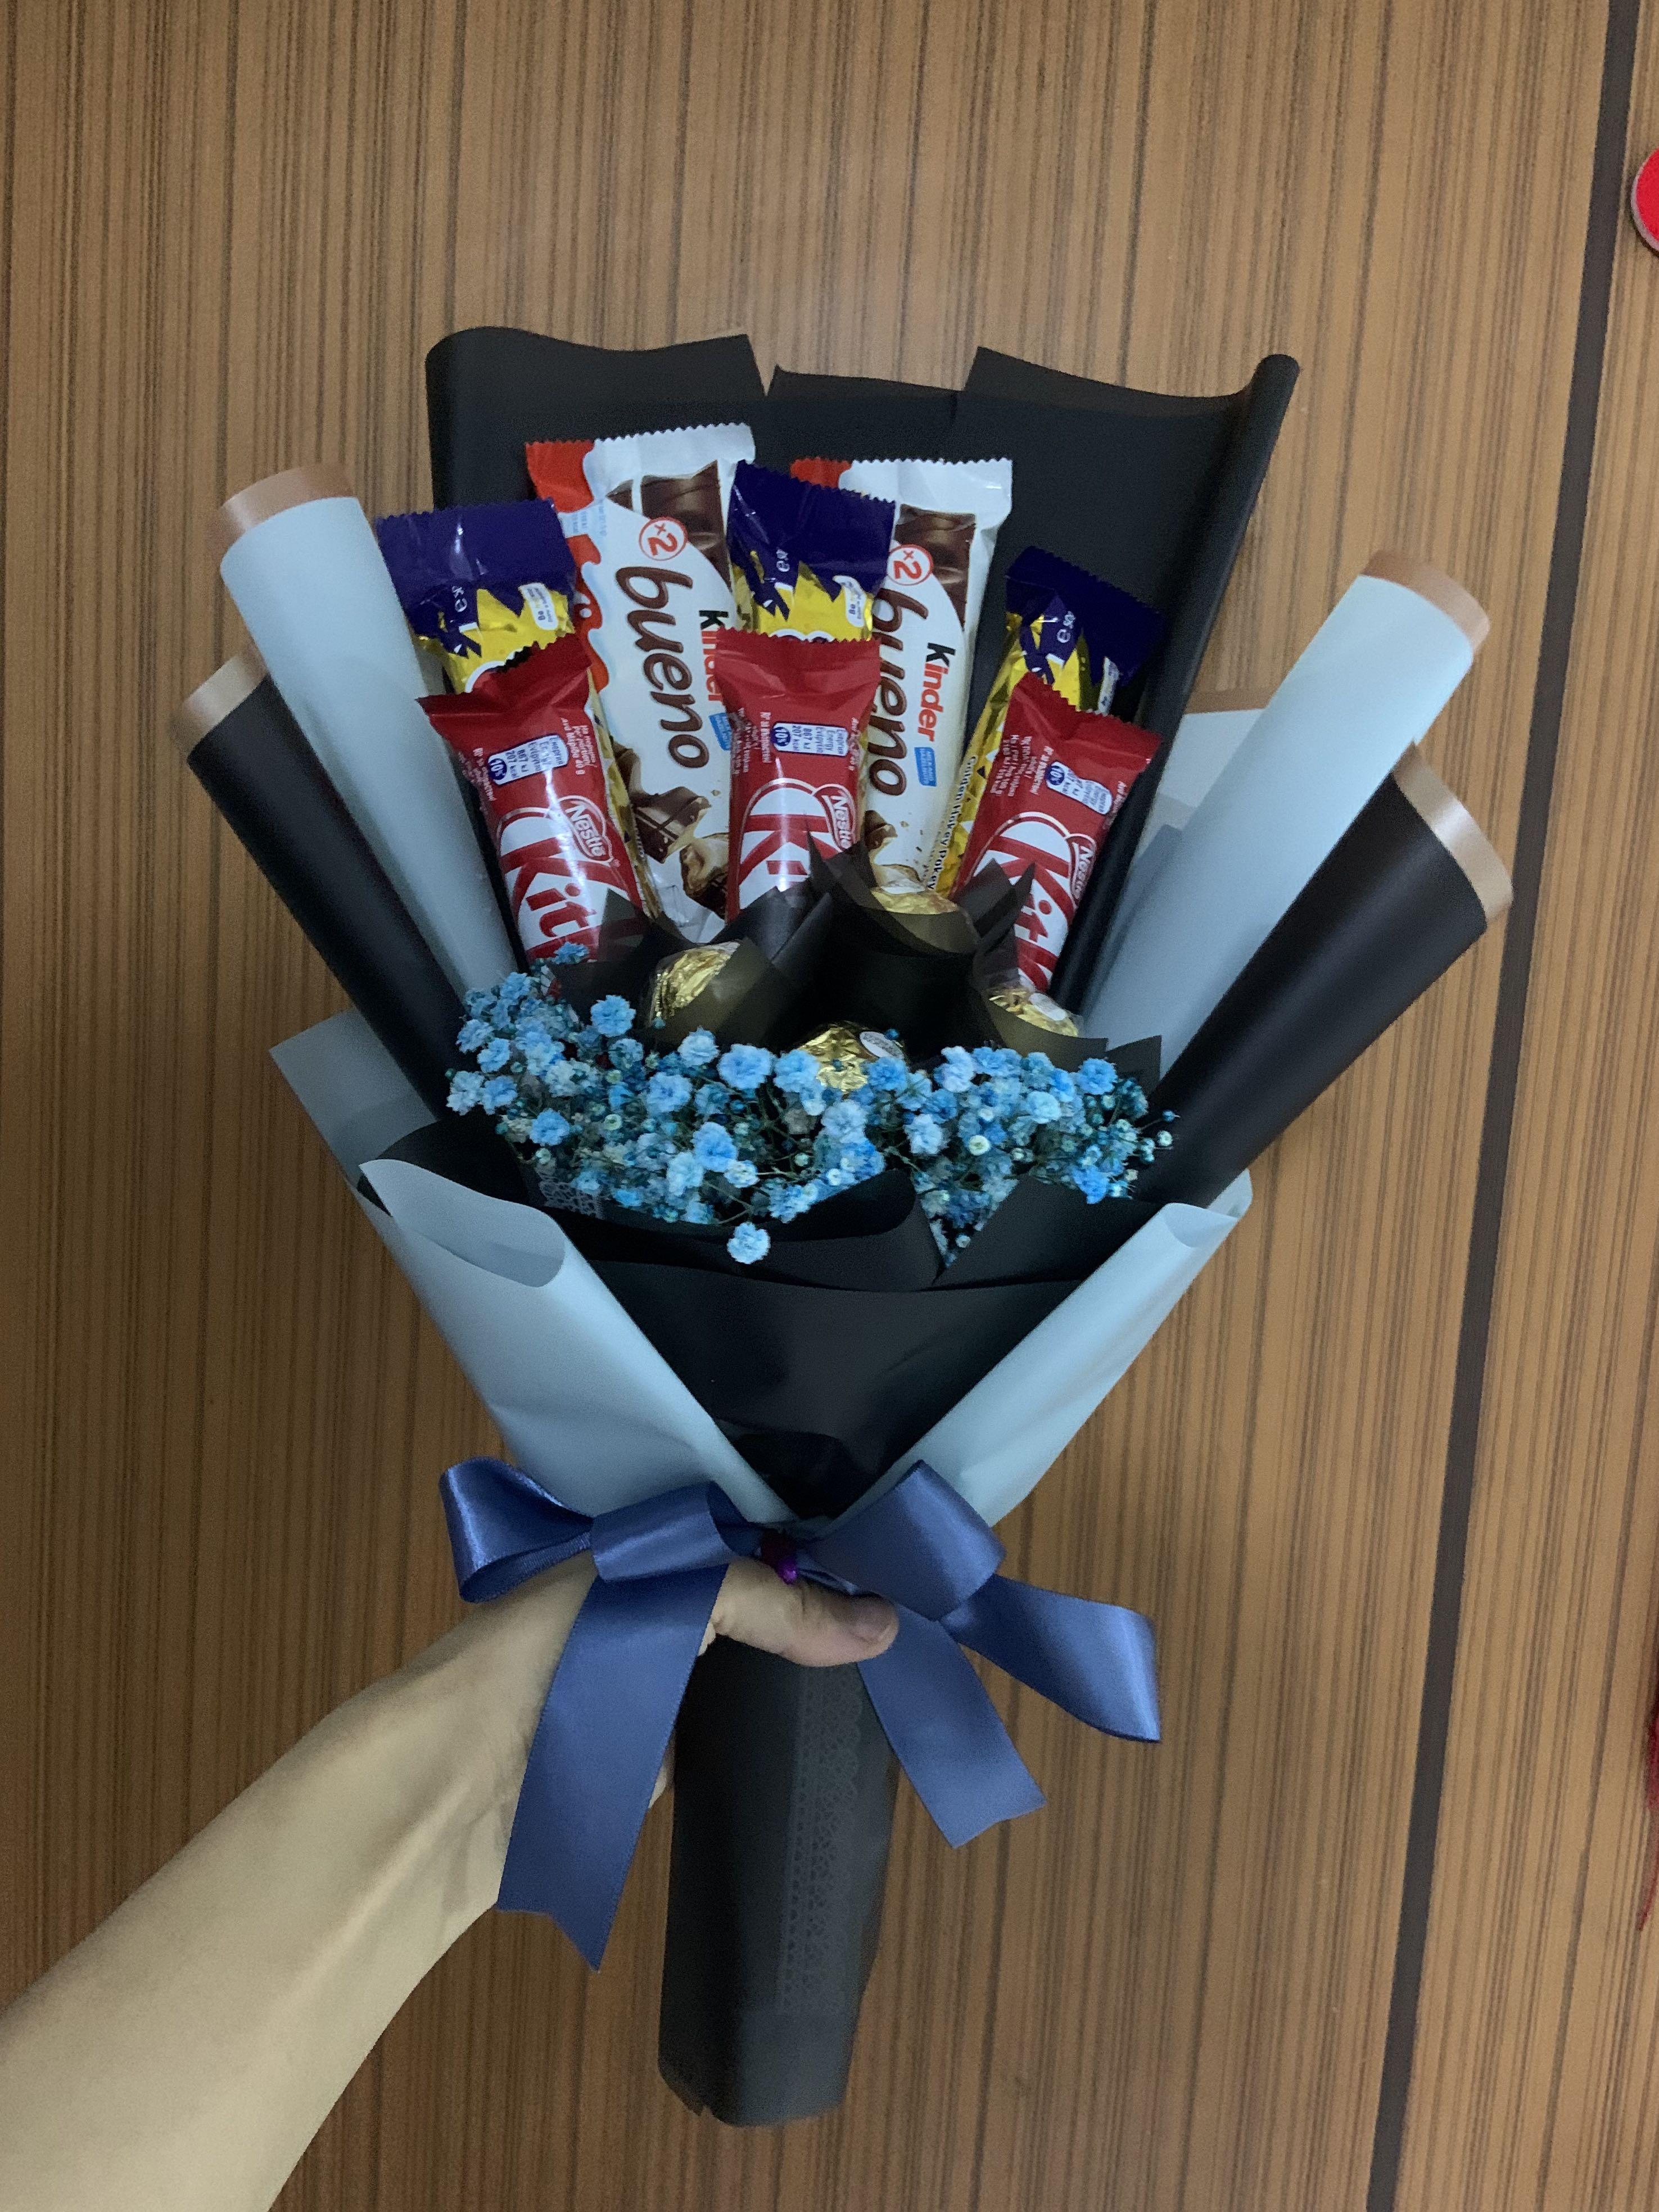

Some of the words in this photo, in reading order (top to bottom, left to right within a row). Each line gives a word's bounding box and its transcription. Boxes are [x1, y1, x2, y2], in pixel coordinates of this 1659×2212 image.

[615, 566, 709, 768] bueno
[868, 587, 929, 796] bueno
[917, 642, 956, 742] Kinder
[792, 725, 802, 738] 207
[825, 730, 836, 752] Energy
[955, 756, 977, 801] Golden
[940, 804, 961, 845] Hokey
[927, 849, 947, 890] Pokey
